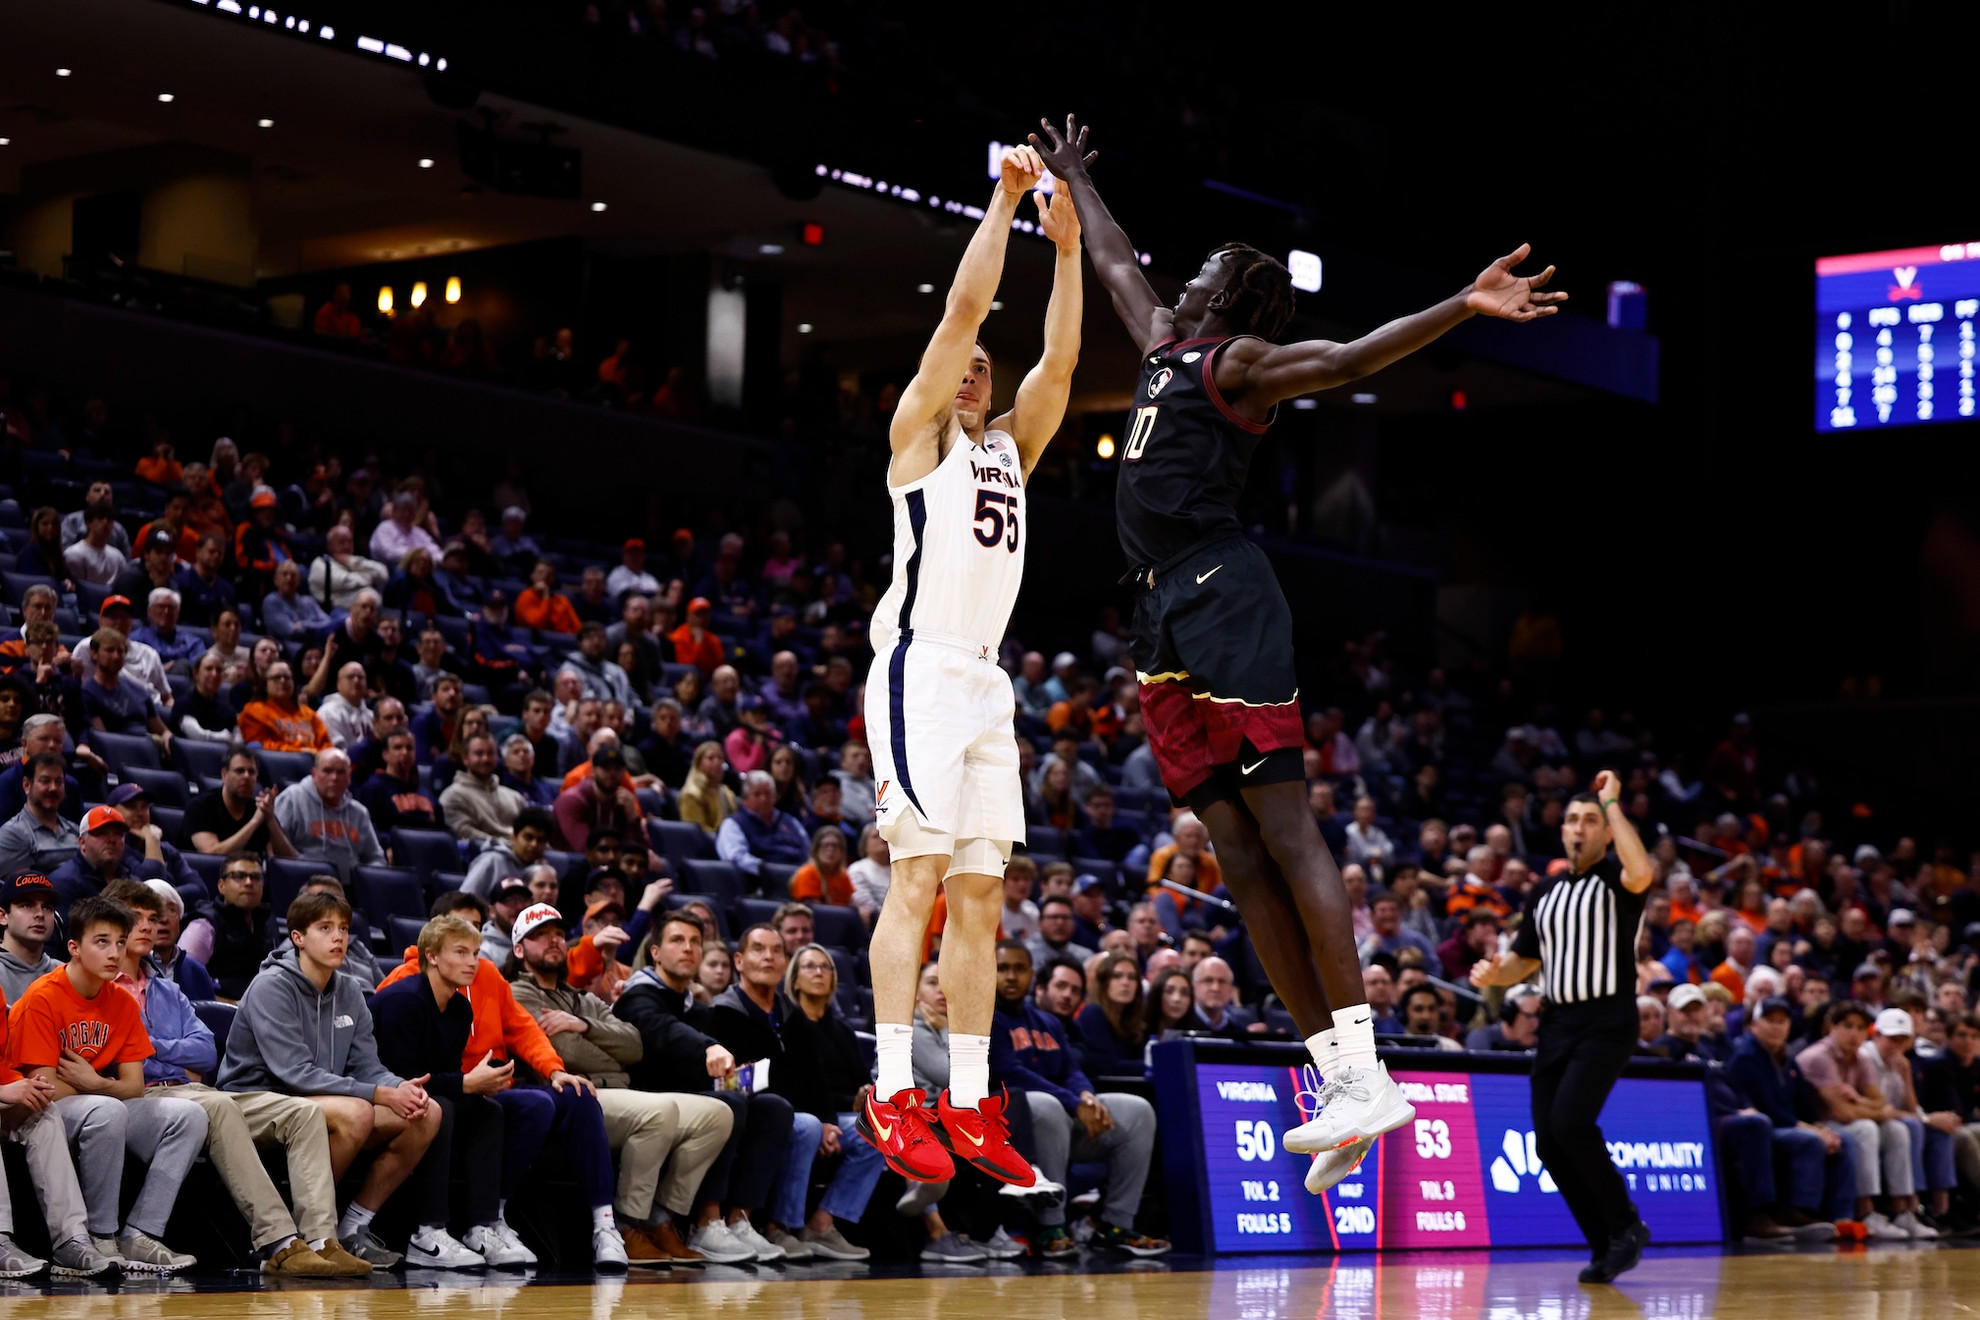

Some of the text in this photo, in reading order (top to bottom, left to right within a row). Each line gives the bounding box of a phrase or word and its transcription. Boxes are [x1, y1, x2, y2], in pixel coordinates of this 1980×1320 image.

[1122, 405, 1159, 462] 10
[973, 489, 1018, 553] 55
[1216, 1082, 1277, 1102] VIRGINIA
[1398, 1082, 1469, 1104] ORIDA STATE
[1236, 1120, 1275, 1162] 50
[1414, 1119, 1452, 1159] 53
[1267, 1181, 1280, 1201] 2
[1443, 1180, 1455, 1201] 3
[1646, 1173, 1707, 1192] UNION
[1237, 1213, 1292, 1234] FOULS 5
[1335, 1206, 1375, 1234] 2ND
[1416, 1210, 1466, 1232] FOULS 6
